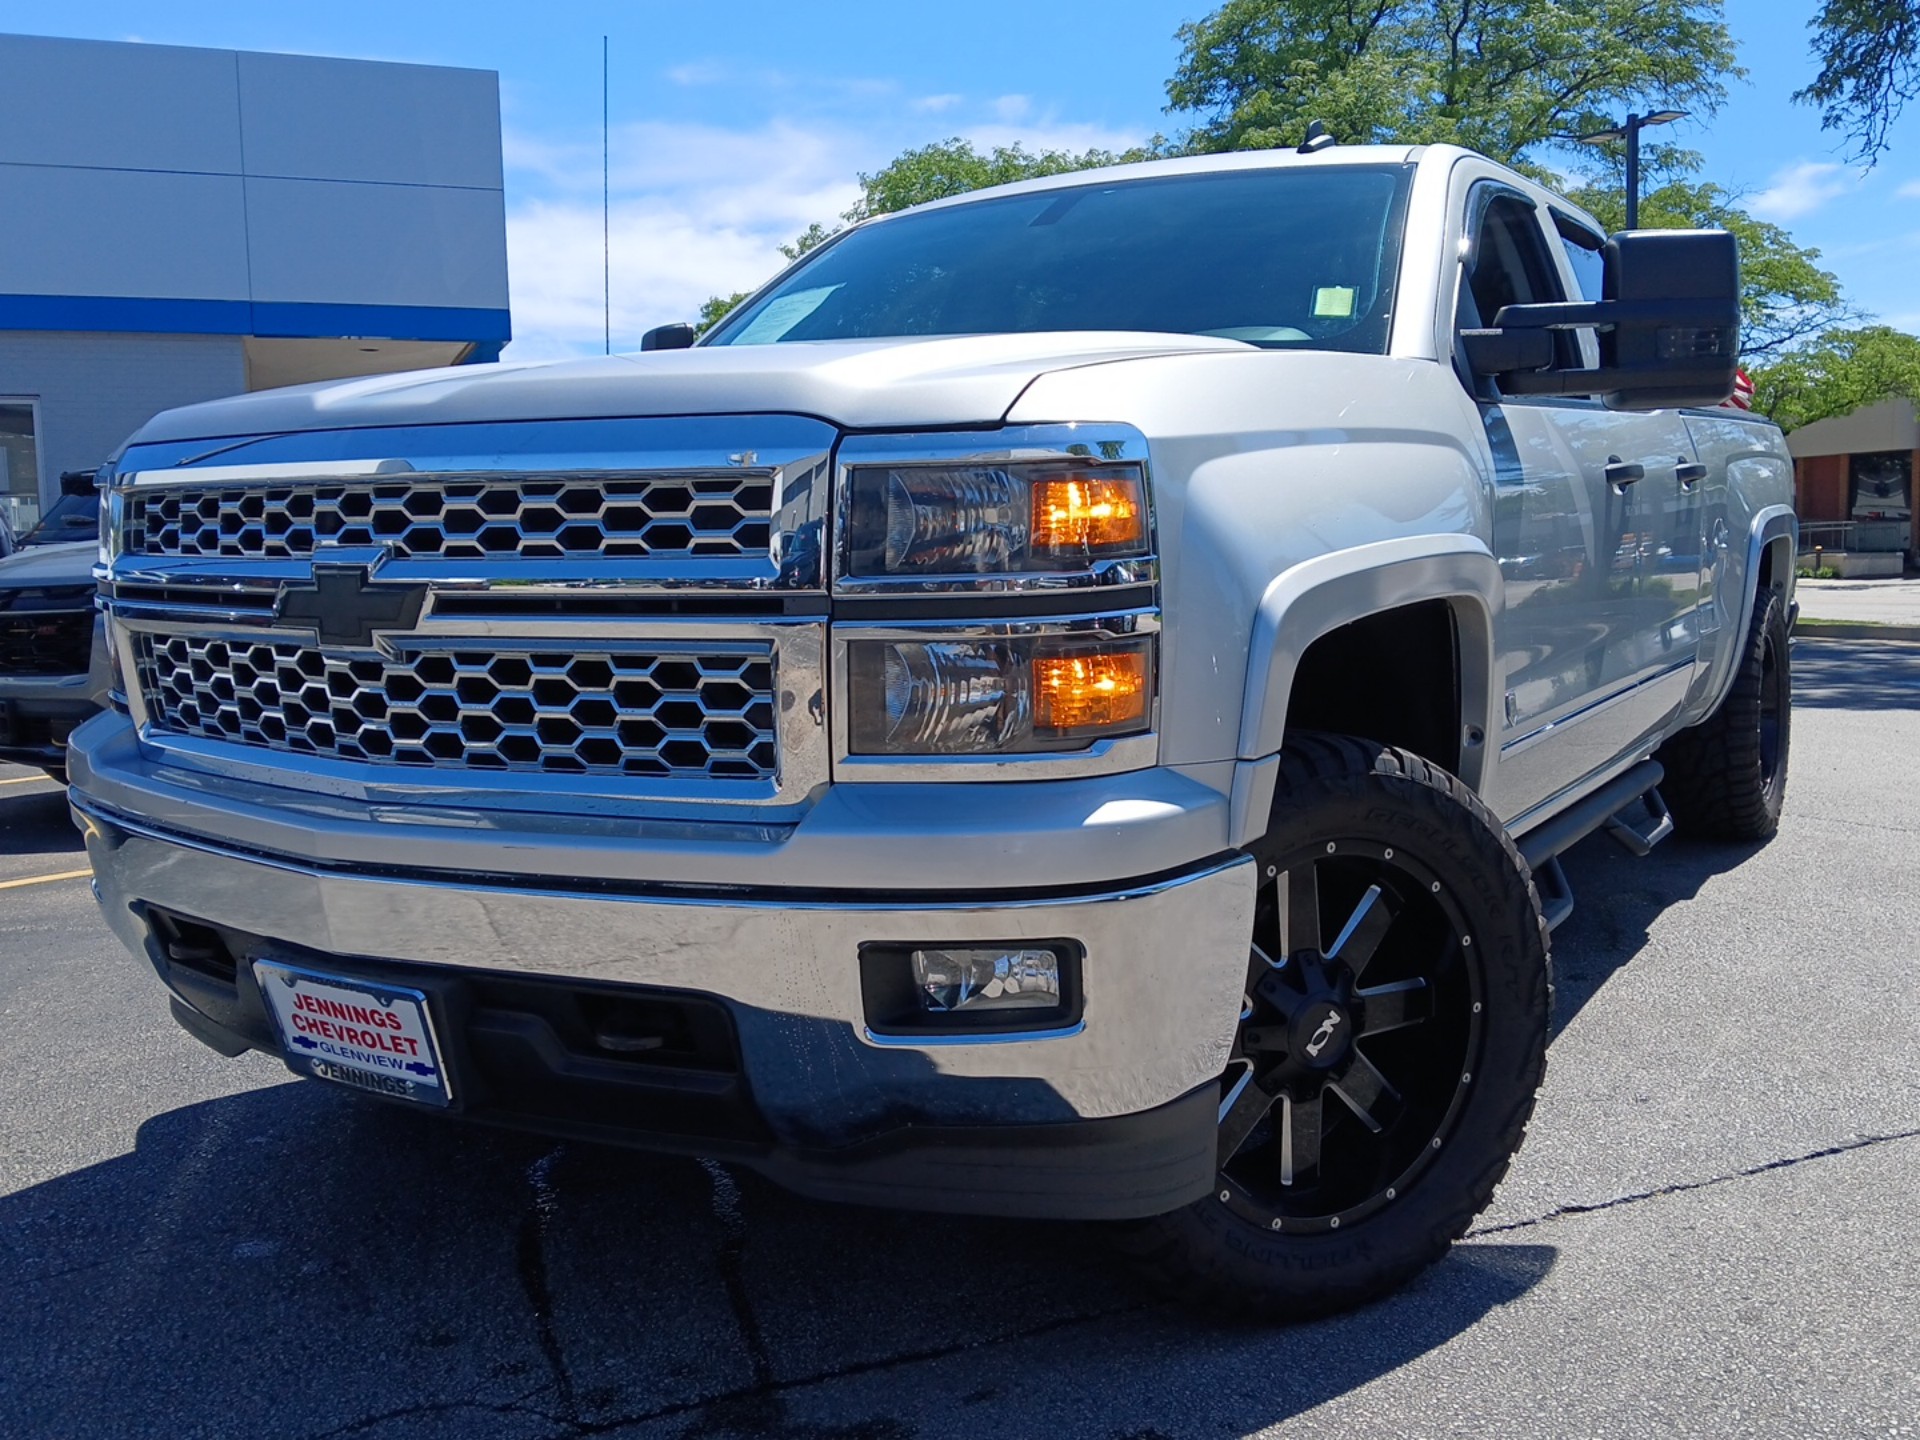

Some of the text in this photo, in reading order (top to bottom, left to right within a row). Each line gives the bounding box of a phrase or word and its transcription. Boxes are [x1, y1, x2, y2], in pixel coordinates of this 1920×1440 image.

[293, 993, 402, 1030] JENNINGS
[292, 1014, 418, 1057] CHEVROLET
[319, 1040, 404, 1070] GLENVIEW
[320, 1063, 407, 1095] JENNINGS
